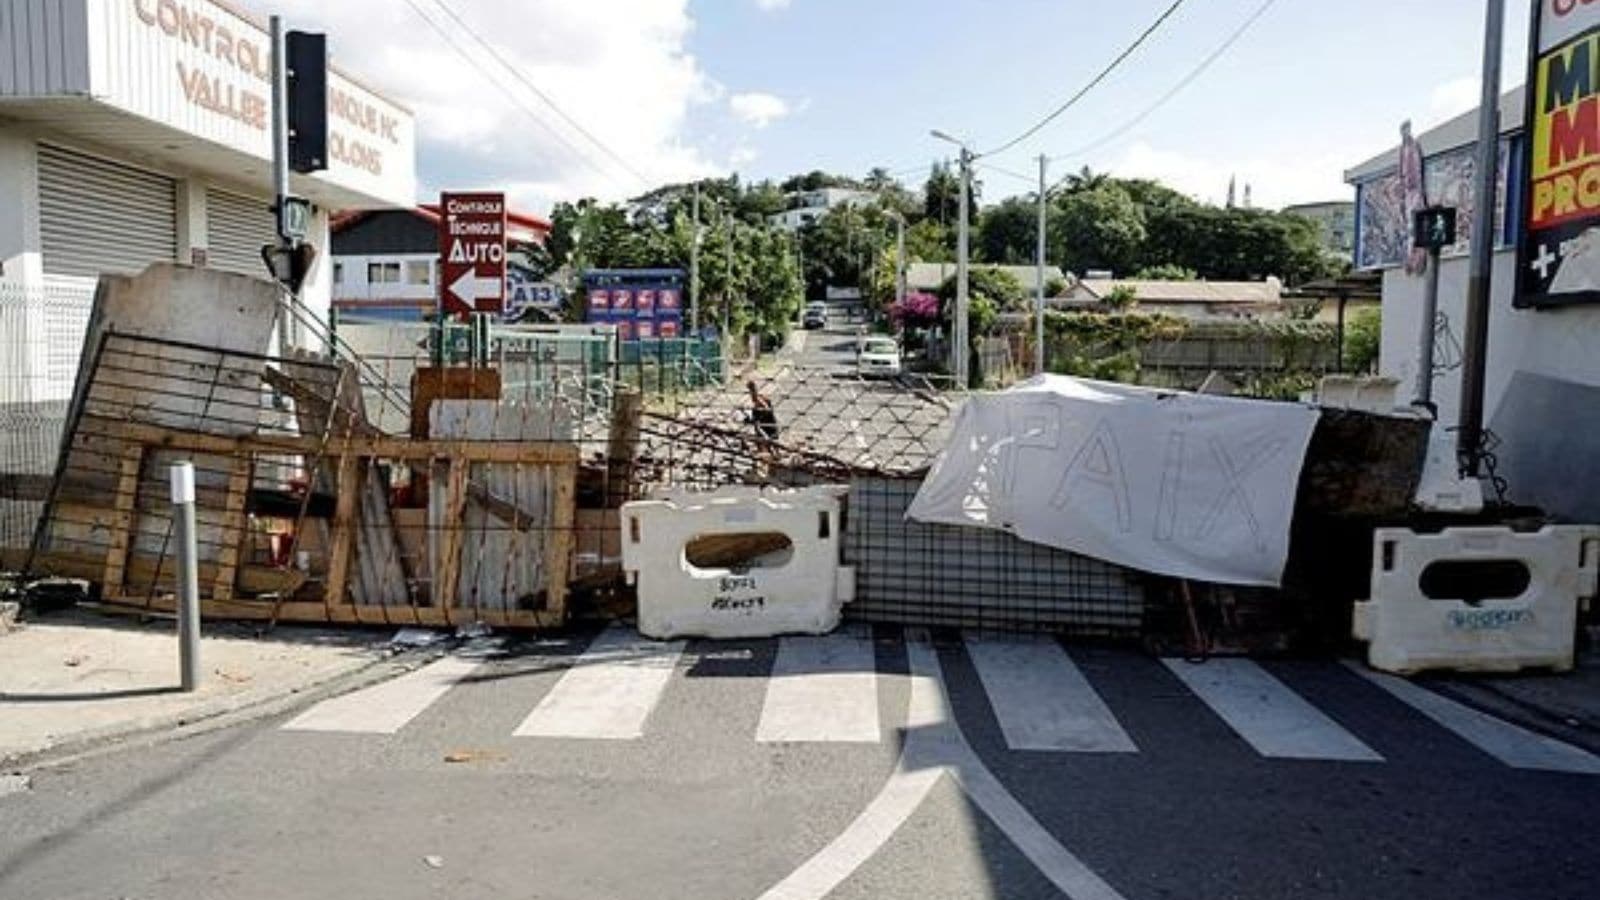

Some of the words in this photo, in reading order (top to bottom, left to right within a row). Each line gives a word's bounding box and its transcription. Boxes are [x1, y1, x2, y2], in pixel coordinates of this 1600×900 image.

[134, 0, 271, 85] CONTROL
[330, 87, 377, 134] NIQUE
[330, 132, 382, 175] OLONS
[447, 199, 502, 214] CONTROLE
[447, 214, 502, 235] TECHNIQUE
[447, 238, 503, 263] AUTO
[1001, 401, 1291, 554] PAIX
